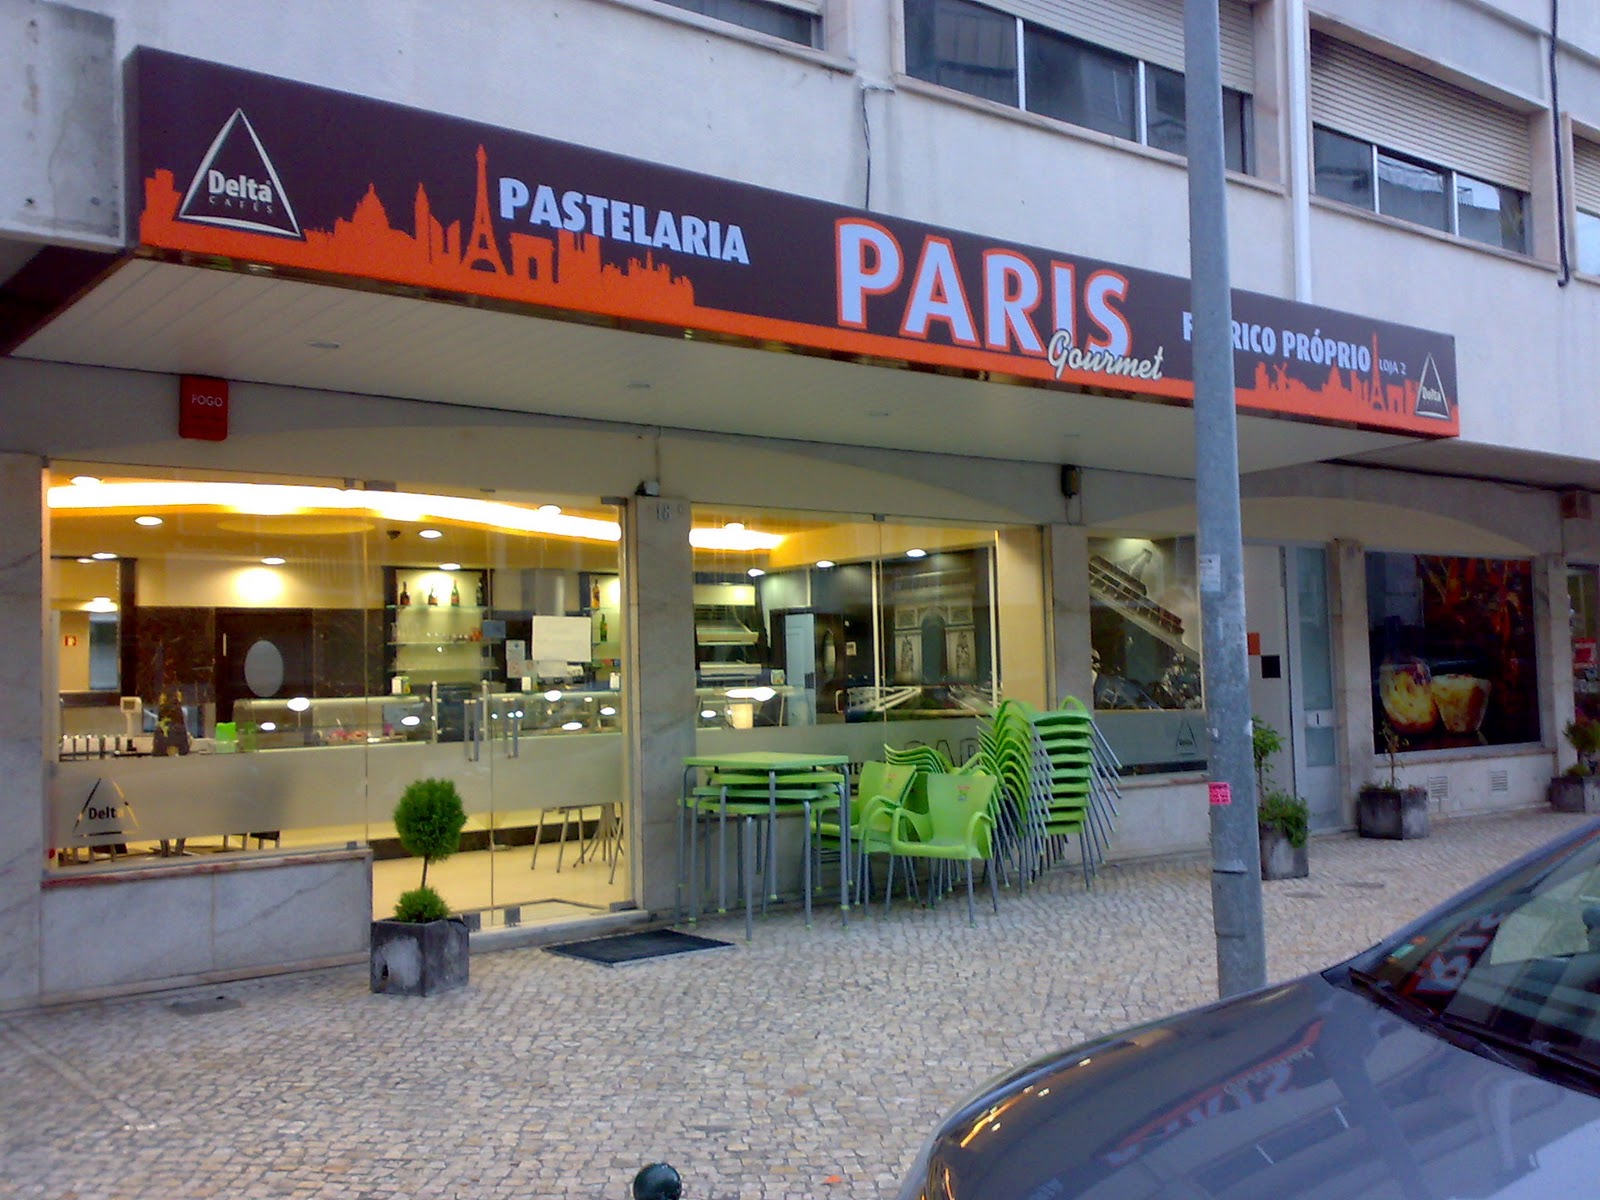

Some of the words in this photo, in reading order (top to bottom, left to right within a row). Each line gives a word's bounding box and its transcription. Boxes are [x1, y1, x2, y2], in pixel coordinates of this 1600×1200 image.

[208, 169, 273, 203] Delta
[499, 177, 750, 265] PASTELARIA
[835, 218, 1133, 357] PARIS
[1048, 328, 1164, 381] Gourmet
[1182, 310, 1276, 356] FRICO
[1282, 328, 1371, 373] PRÓPRIO
[191, 394, 224, 408] FOGO
